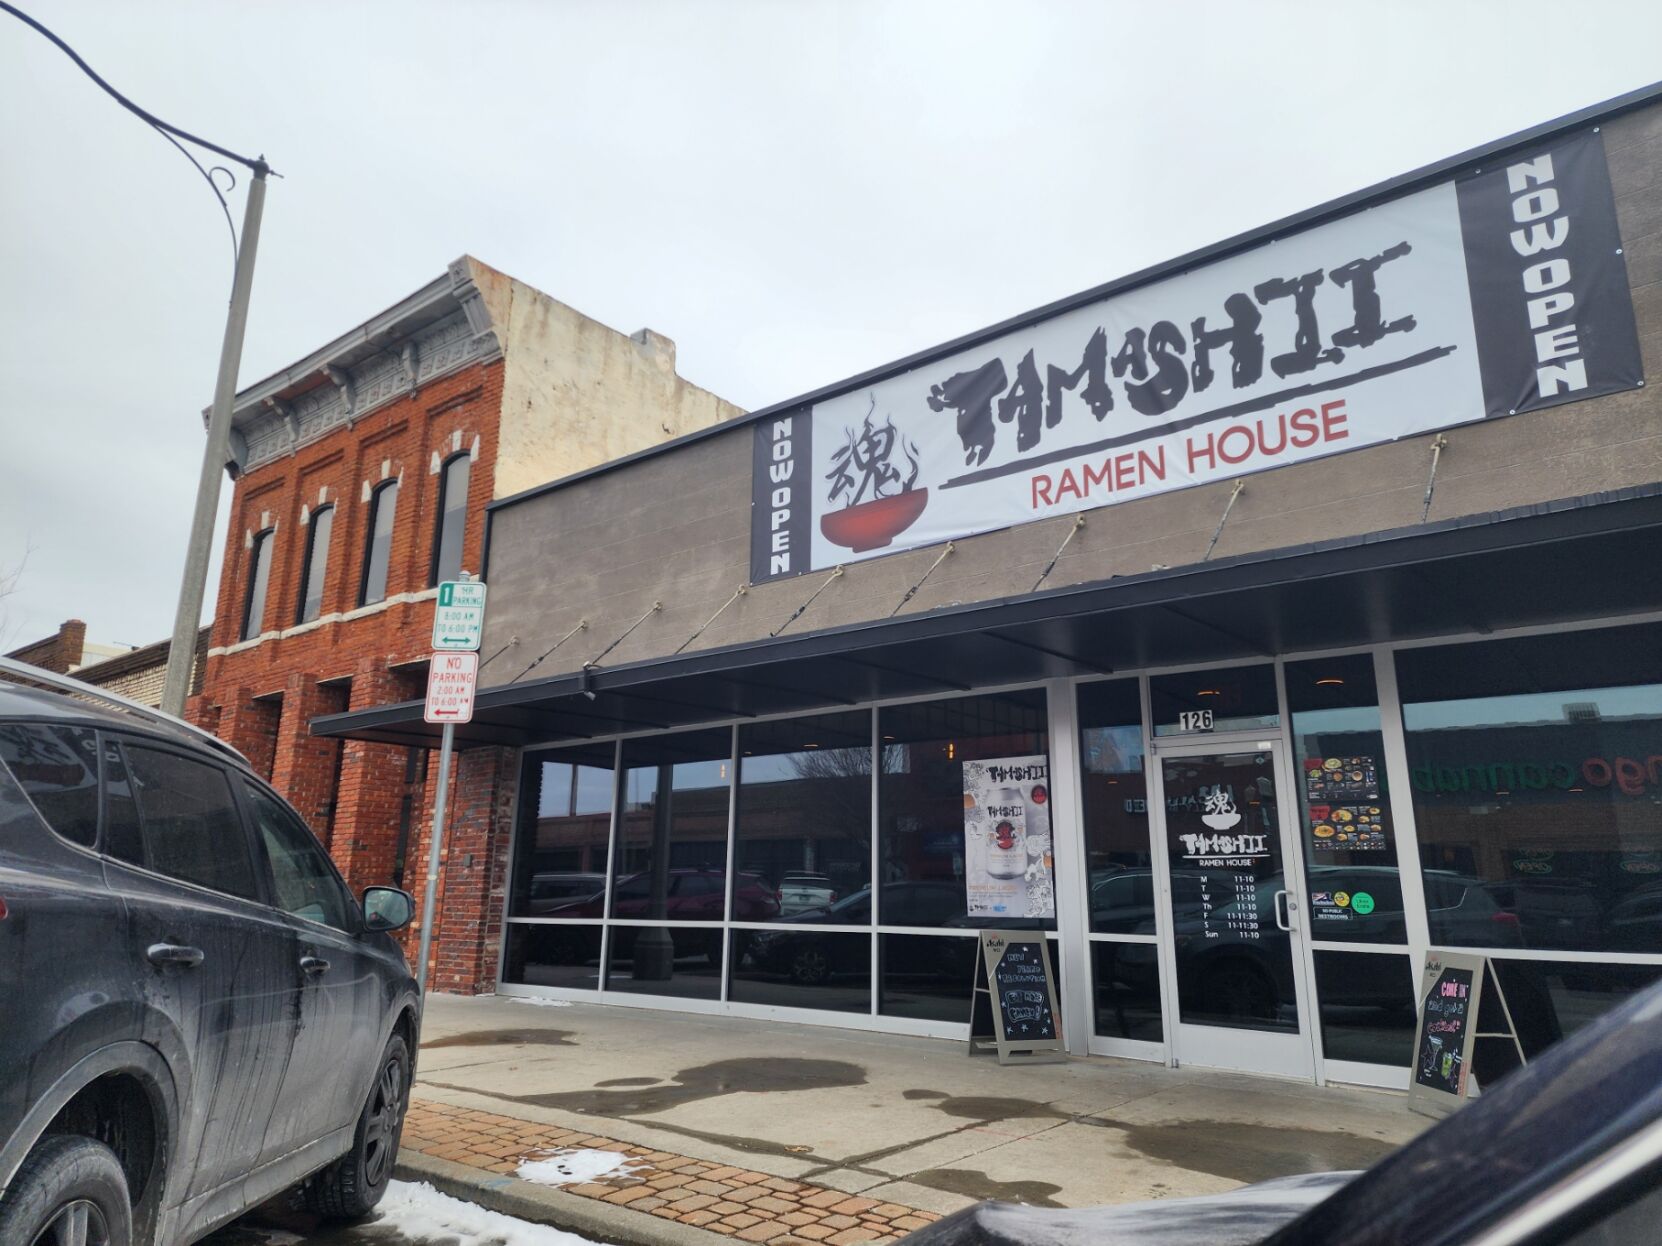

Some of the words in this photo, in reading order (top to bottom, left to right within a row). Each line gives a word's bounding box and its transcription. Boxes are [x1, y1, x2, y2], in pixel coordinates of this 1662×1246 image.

[1506, 153, 1569, 257] NOW
[1522, 258, 1589, 399] OPEN
[926, 240, 1417, 467] TAMASHII
[769, 417, 794, 484] NOW
[1031, 445, 1166, 509] RAMEN
[1186, 399, 1349, 474] HOUSE
[770, 486, 791, 576] OPEN
[443, 586, 451, 604] 1
[461, 586, 474, 595] HR
[453, 596, 483, 606] PARKING
[444, 611, 462, 621] 8:00
[464, 612, 474, 620] AM
[438, 624, 447, 633] TO
[448, 624, 466, 633] 6:00
[467, 624, 478, 633] PM
[446, 657, 462, 670] NO
[432, 672, 473, 684] PARKING
[437, 685, 454, 695] 2:00
[455, 686, 465, 695] AM
[431, 697, 439, 706] TO
[440, 697, 457, 706] 6:00
[1181, 710, 1213, 730] 126
[1199, 859, 1224, 867] RAMEN
[1226, 859, 1252, 867] HOUSE
[1200, 875, 1208, 883] M
[1234, 875, 1254, 883] 11-10
[1201, 884, 1206, 892] T
[1237, 903, 1257, 911] 11-10
[1227, 912, 1258, 920] 11-11:30
[1205, 930, 1219, 938] Sun
[1239, 931, 1260, 939] 11-10
